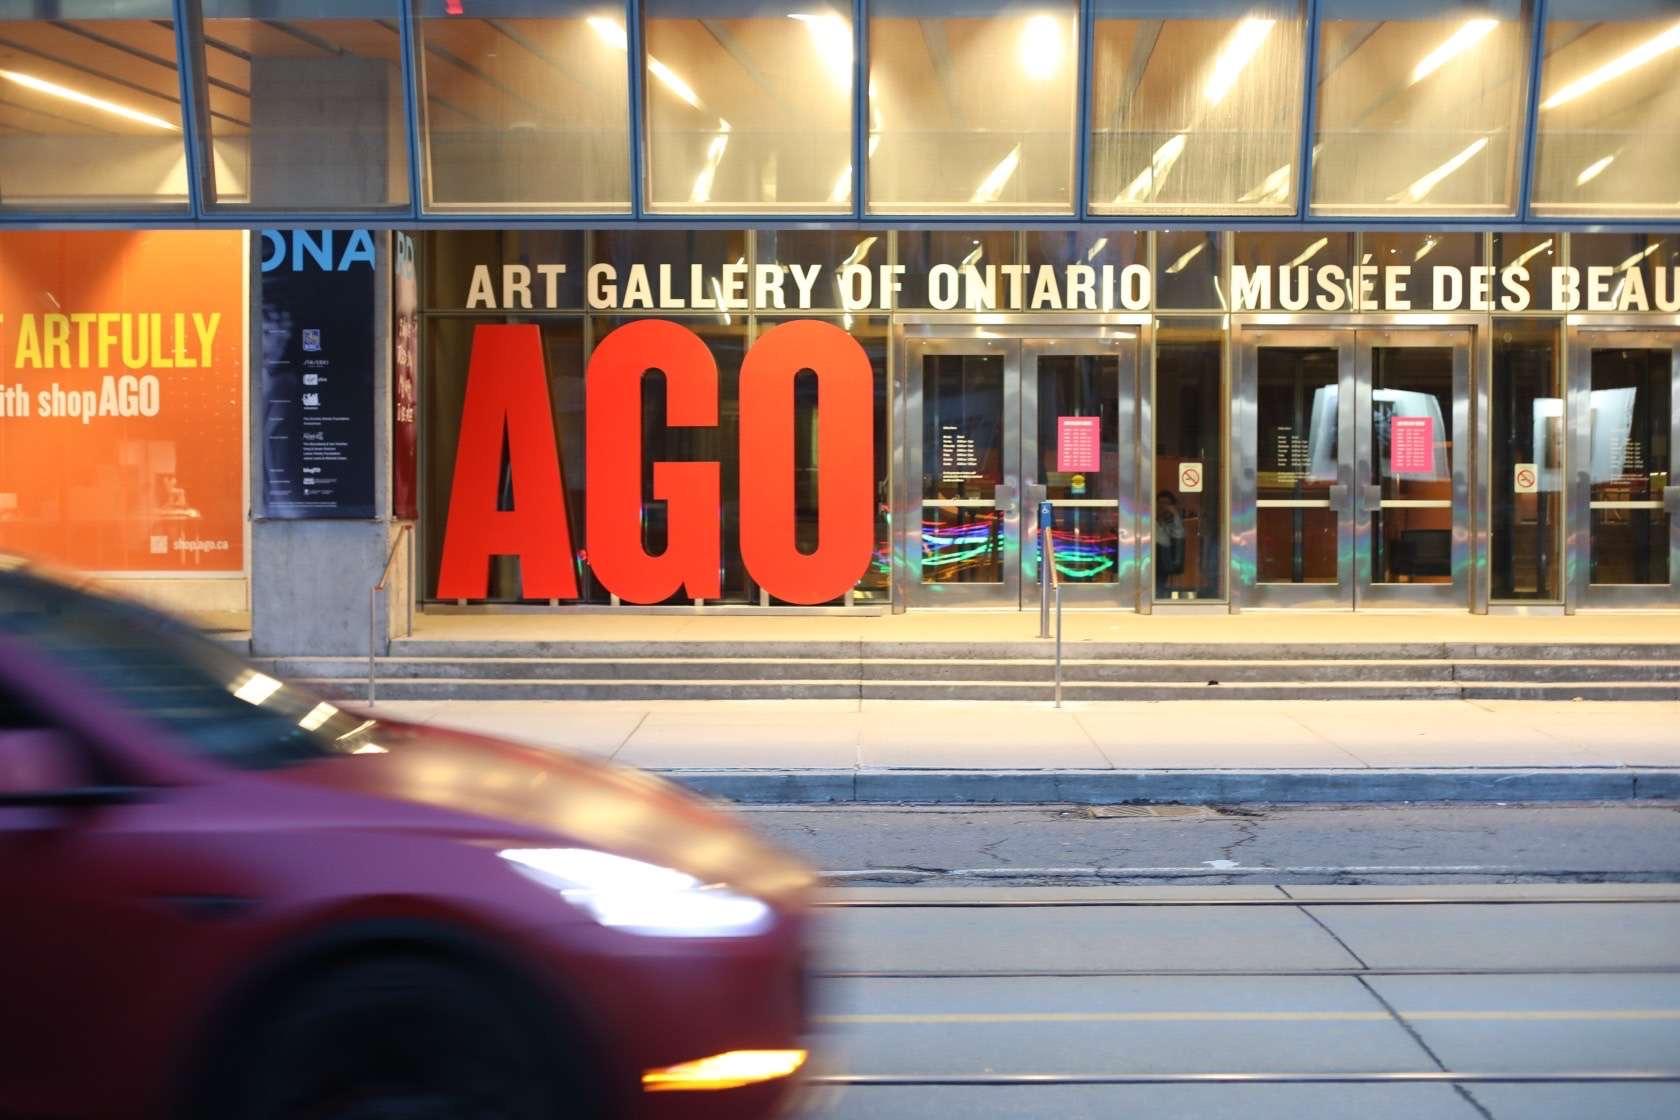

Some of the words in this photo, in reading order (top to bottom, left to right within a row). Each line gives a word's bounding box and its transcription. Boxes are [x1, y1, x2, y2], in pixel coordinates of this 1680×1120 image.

[466, 264, 566, 309] ART
[587, 264, 821, 309] GALLERY
[841, 264, 905, 310] OF
[928, 264, 1152, 310] ONTARIO
[1231, 255, 1411, 310] MUSÉE
[1432, 265, 1530, 311] DES
[1551, 265, 1680, 312] BEAU
[15, 312, 221, 369] ARTFULLY
[38, 374, 160, 425] shopAGO
[438, 319, 874, 605] AGO
